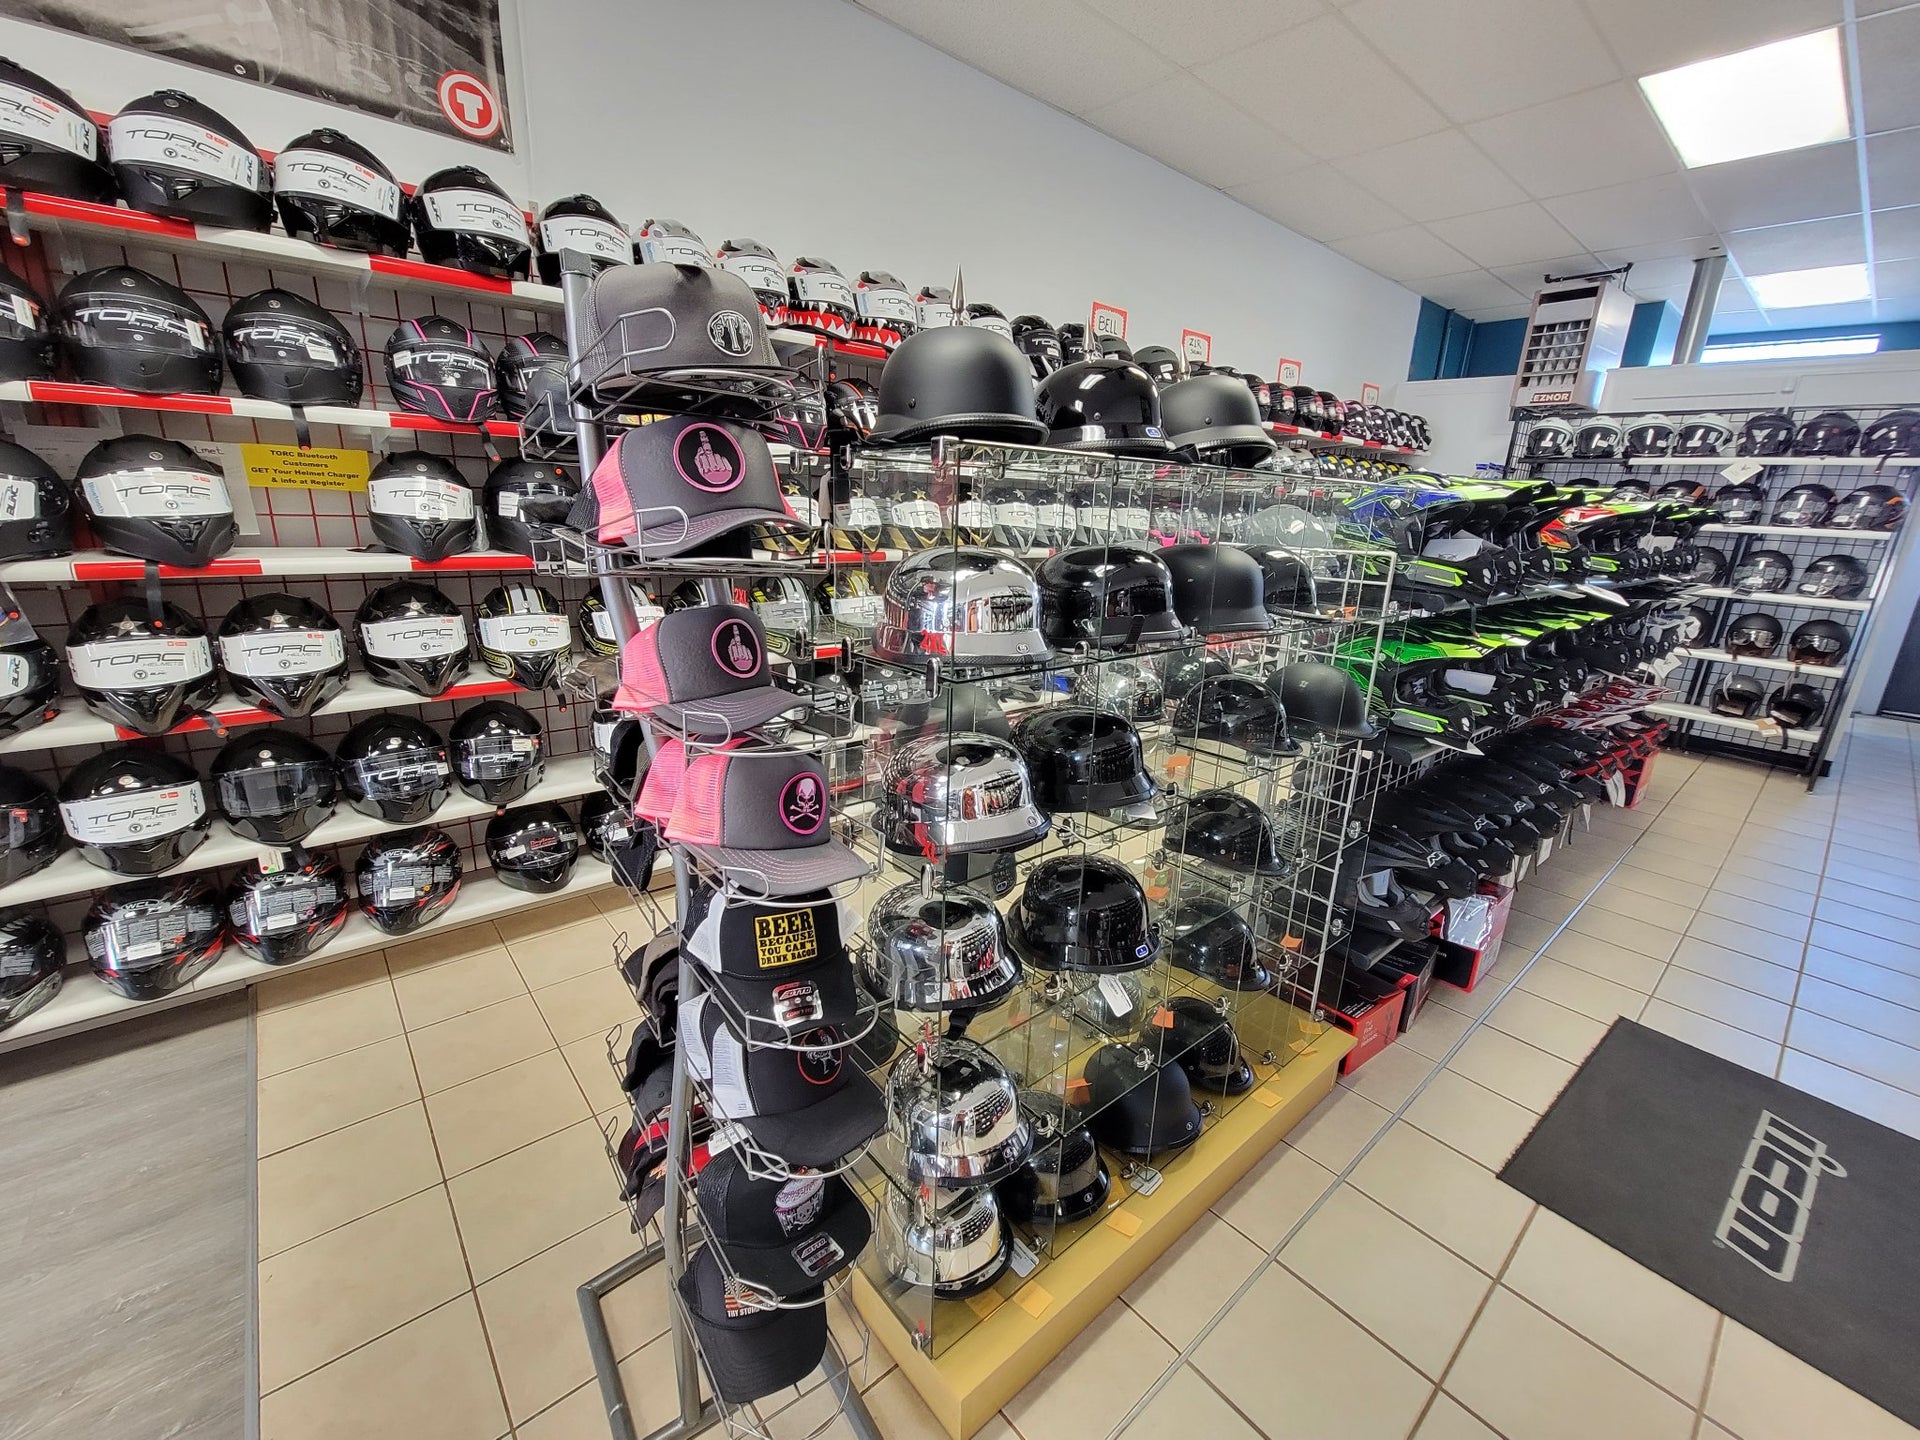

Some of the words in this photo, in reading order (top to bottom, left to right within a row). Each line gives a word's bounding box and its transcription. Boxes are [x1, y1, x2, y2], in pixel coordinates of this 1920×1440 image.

[126, 129, 224, 160] TORC
[287, 162, 371, 191] TORC
[456, 203, 522, 230] TORC
[565, 228, 625, 249] TORC
[75, 309, 189, 337] TORC
[1098, 315, 1118, 335] BELL
[233, 326, 332, 348] TORC
[411, 351, 490, 370] TORC
[282, 460, 328, 468] Customers
[297, 452, 338, 460] Bluetooth
[295, 469, 325, 477] Helmet
[327, 471, 359, 479] Charger
[310, 479, 345, 487] Register
[116, 484, 211, 498] TORC
[388, 489, 458, 504] TORC
[5, 486, 19, 517] BLINC
[386, 628, 454, 642] TORC
[500, 626, 559, 637] TORC
[242, 644, 323, 657] TORC
[90, 652, 185, 668] TORC
[467, 752, 526, 763] TORC
[361, 762, 440, 781] TORC
[88, 803, 178, 825] TORC
[756, 910, 814, 939] BEER
[759, 930, 815, 948] BECAUSE
[760, 946, 781, 957] YOU
[785, 939, 815, 953] CAN'T
[761, 955, 789, 966] DRINK
[791, 948, 817, 961] BACON
